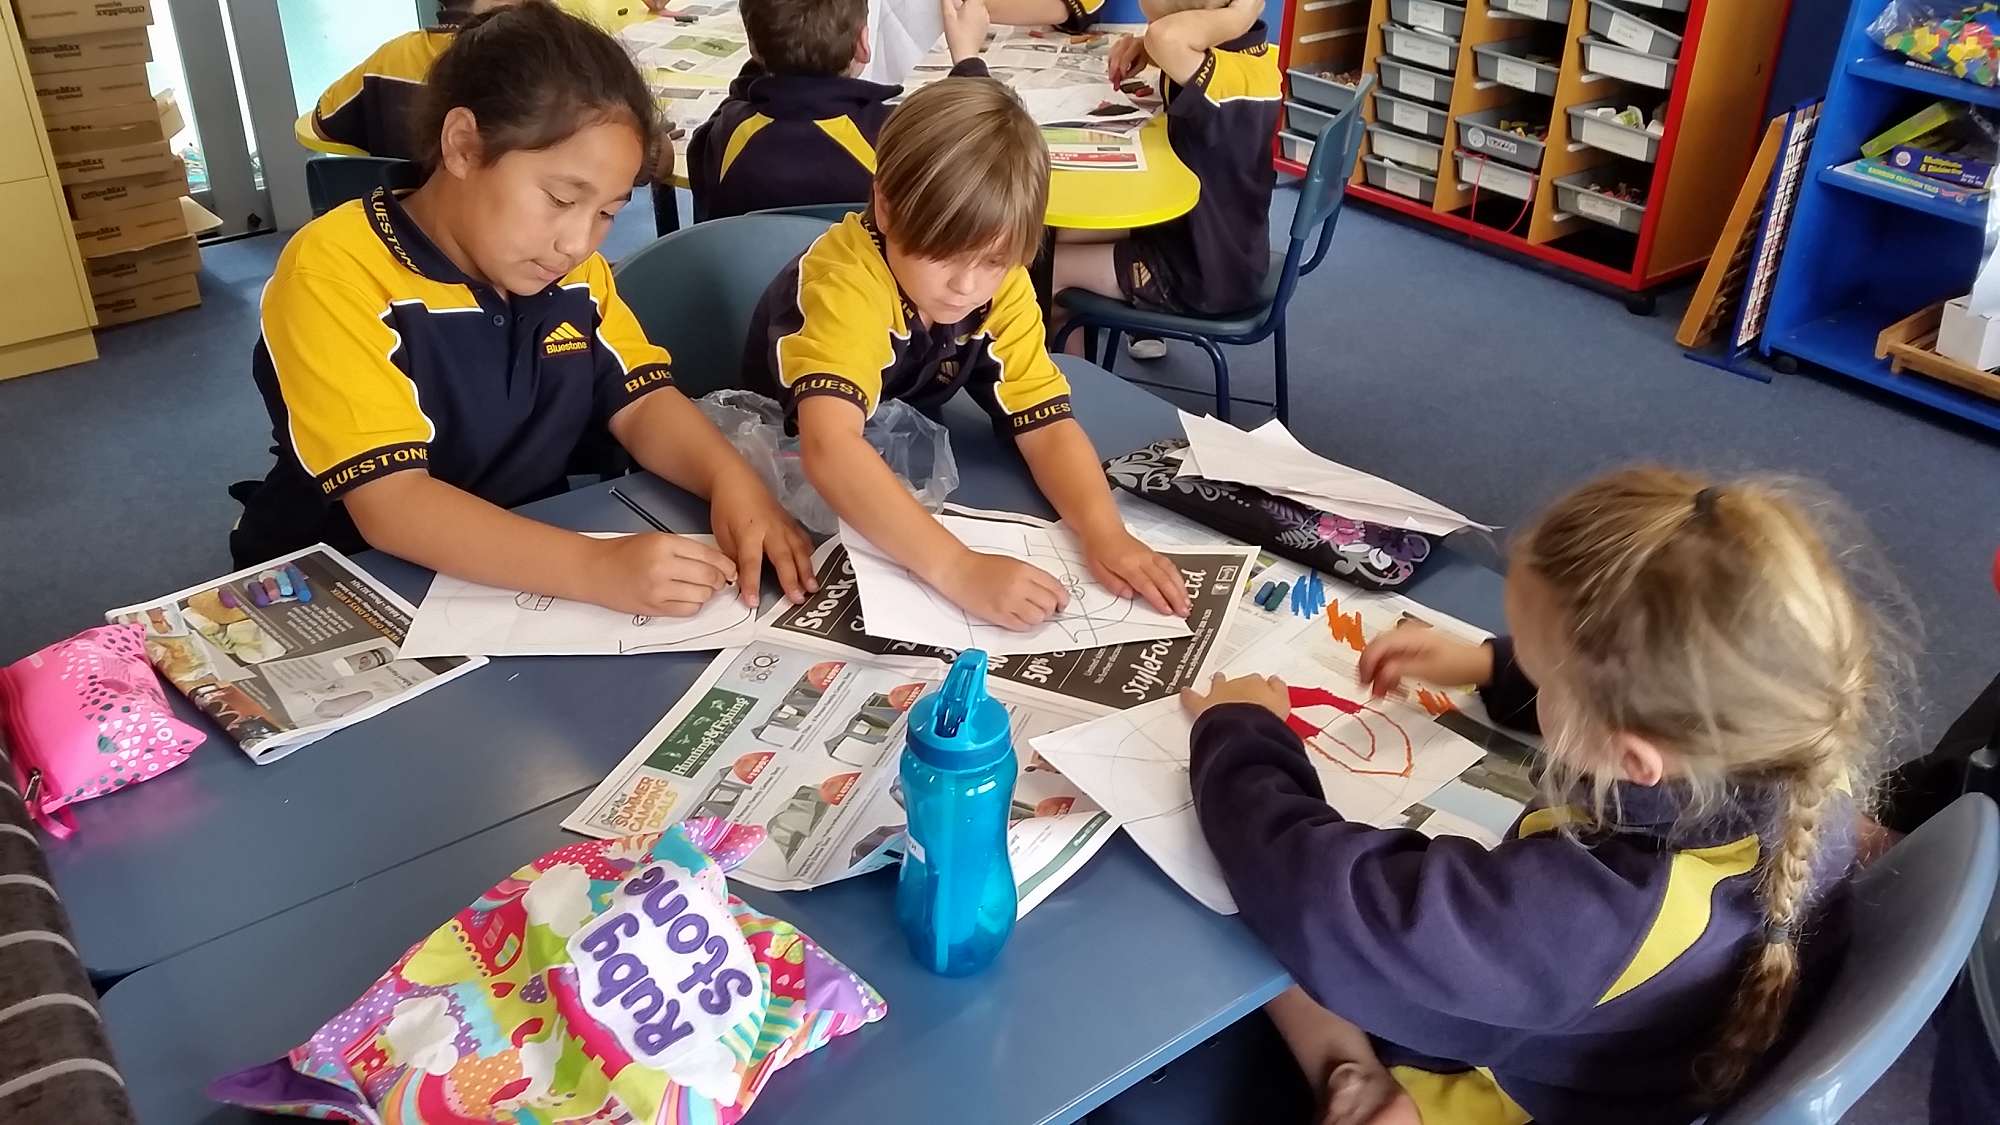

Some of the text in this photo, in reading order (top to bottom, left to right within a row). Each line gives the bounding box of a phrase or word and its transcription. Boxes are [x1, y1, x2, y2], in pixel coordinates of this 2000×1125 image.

[546, 341, 588, 355] Bluestone
[794, 575, 858, 630] Stock
[1021, 656, 1054, 684] 50%
[615, 776, 654, 827] SUMMER
[629, 779, 669, 832] CAMPING
[647, 791, 678, 828] DEALS
[624, 866, 753, 1016] Stone
[580, 912, 695, 1056] Ruby
